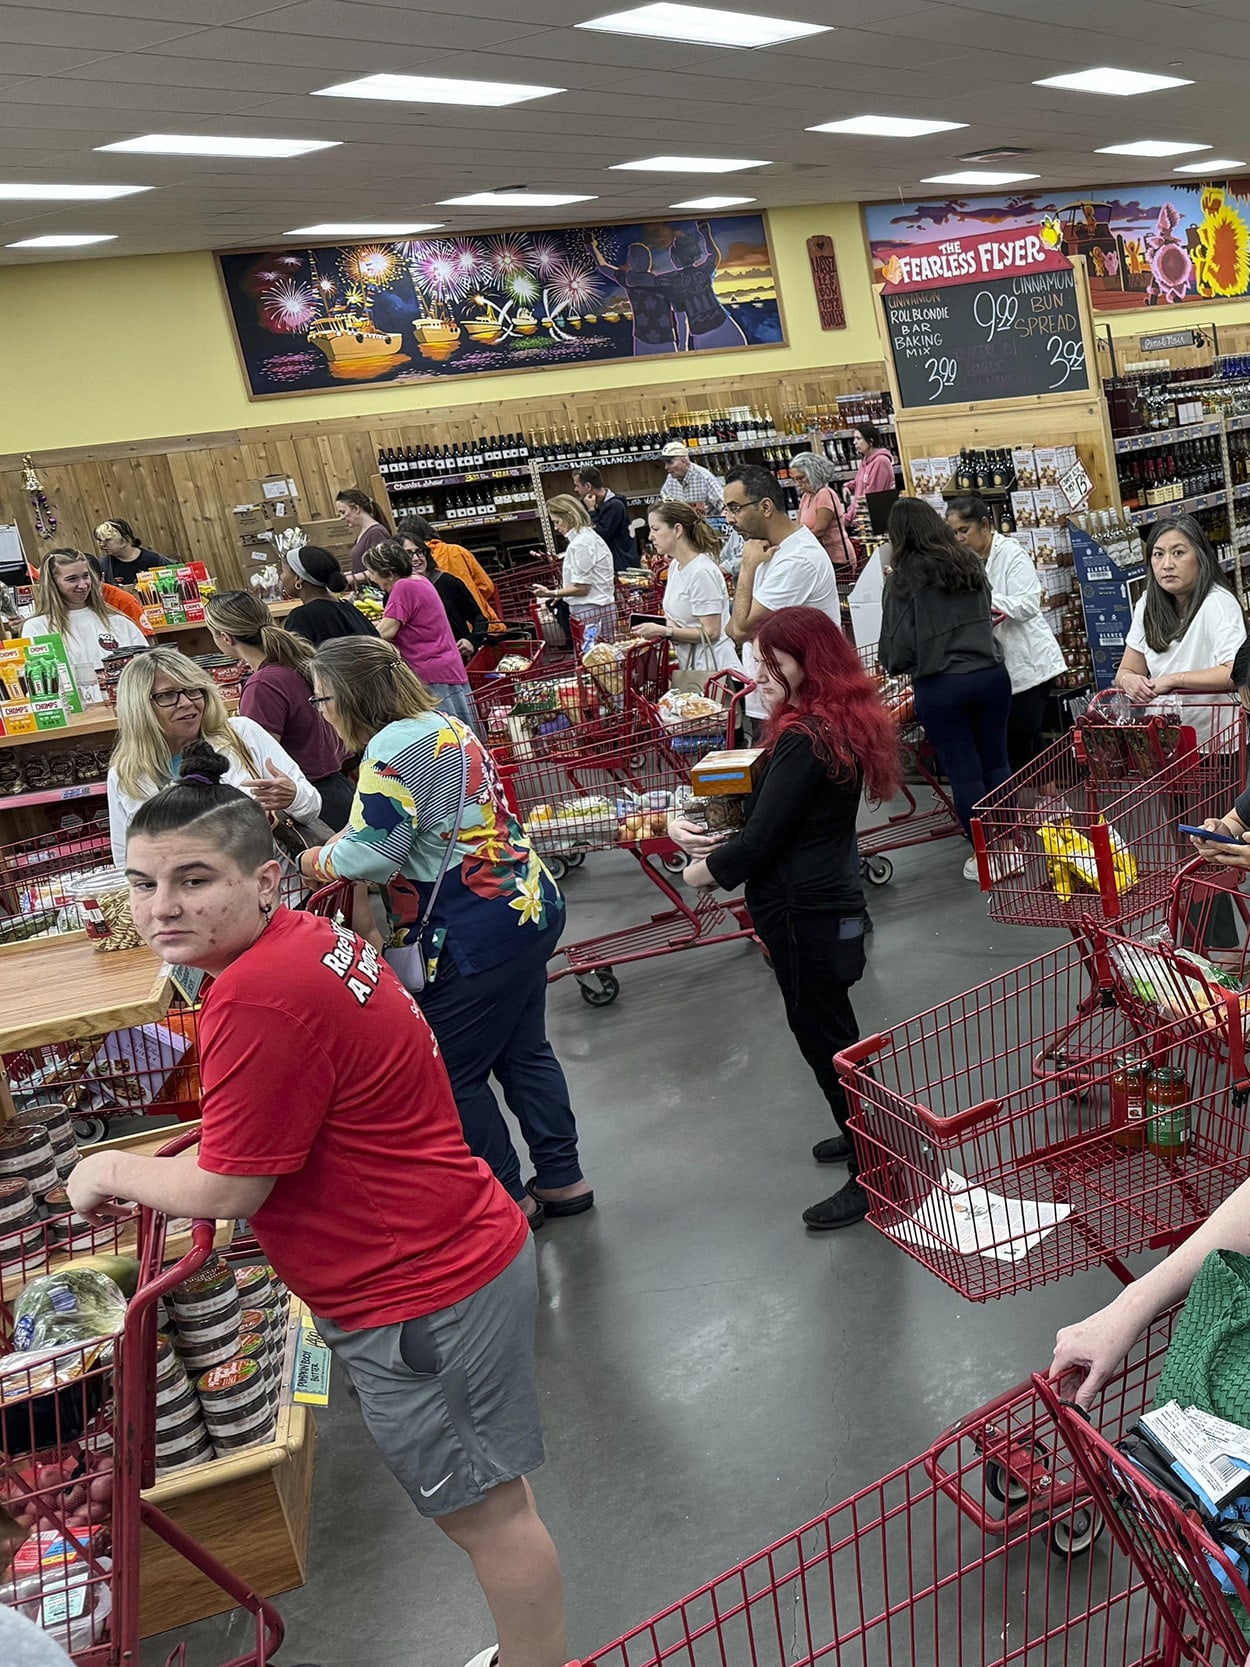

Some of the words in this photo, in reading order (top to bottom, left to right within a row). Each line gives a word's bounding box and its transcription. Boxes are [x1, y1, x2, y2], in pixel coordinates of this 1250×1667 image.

[938, 240, 962, 256] THE
[899, 251, 977, 284] FEARLESS
[978, 235, 1045, 273] FLYER
[1012, 270, 1074, 296] CINNAMON
[1030, 293, 1064, 313] BUN
[901, 322, 932, 336] BAR
[1014, 313, 1077, 338] SPREAD
[894, 333, 943, 351] BAKING
[906, 346, 931, 359] MIX
[5, 705, 29, 715] CHOMPS
[35, 701, 59, 711] CHOMPS
[322, 941, 354, 977] Race
[347, 977, 373, 1004] A
[297, 1363, 309, 1387] PUMPKIN
